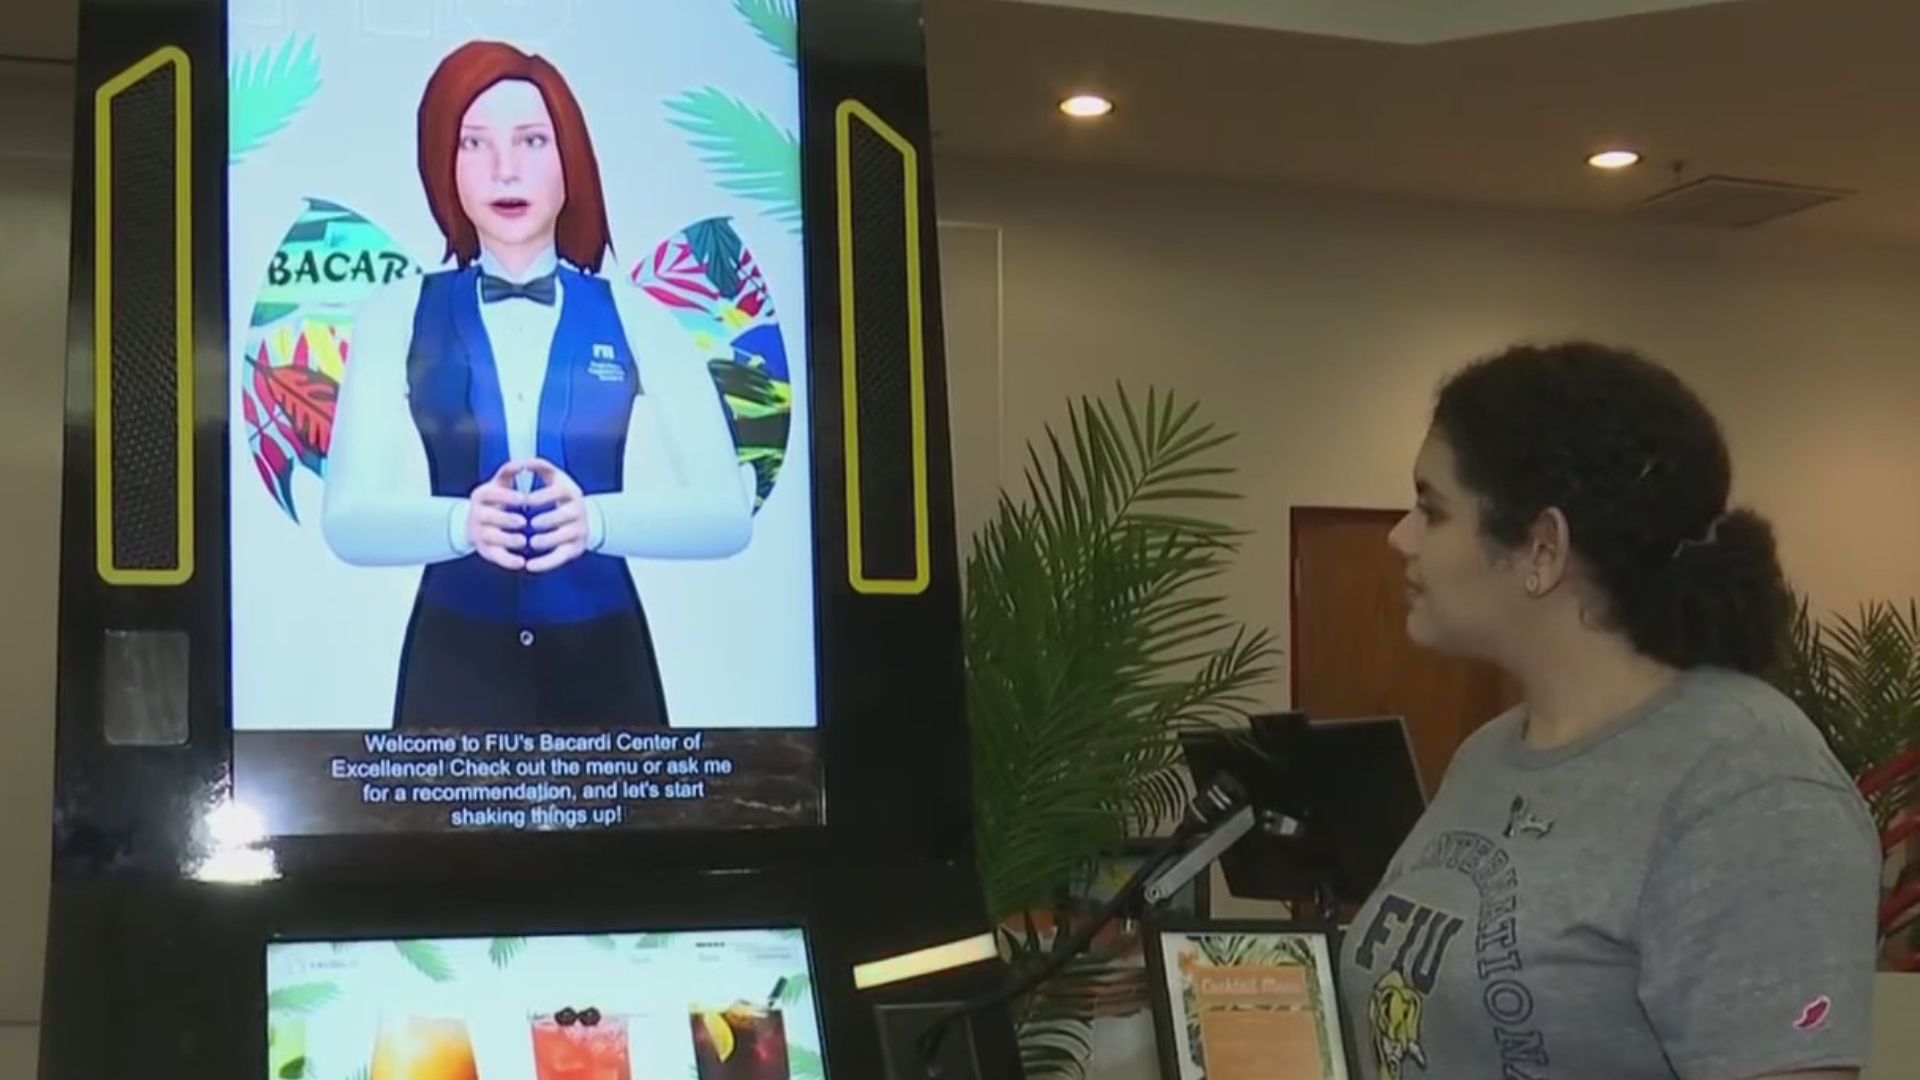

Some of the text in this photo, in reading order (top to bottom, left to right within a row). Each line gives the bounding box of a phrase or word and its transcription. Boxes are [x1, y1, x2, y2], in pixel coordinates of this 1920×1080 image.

[268, 250, 422, 286] BACAR
[364, 731, 703, 752] Welcome to FIU's Bacardi Center of
[331, 756, 732, 778] Excellence! Check out the menu or ask me
[363, 780, 705, 802] for a recommendation, and let's start
[451, 804, 622, 829] shaking things up!
[1355, 893, 1464, 995] FIU
